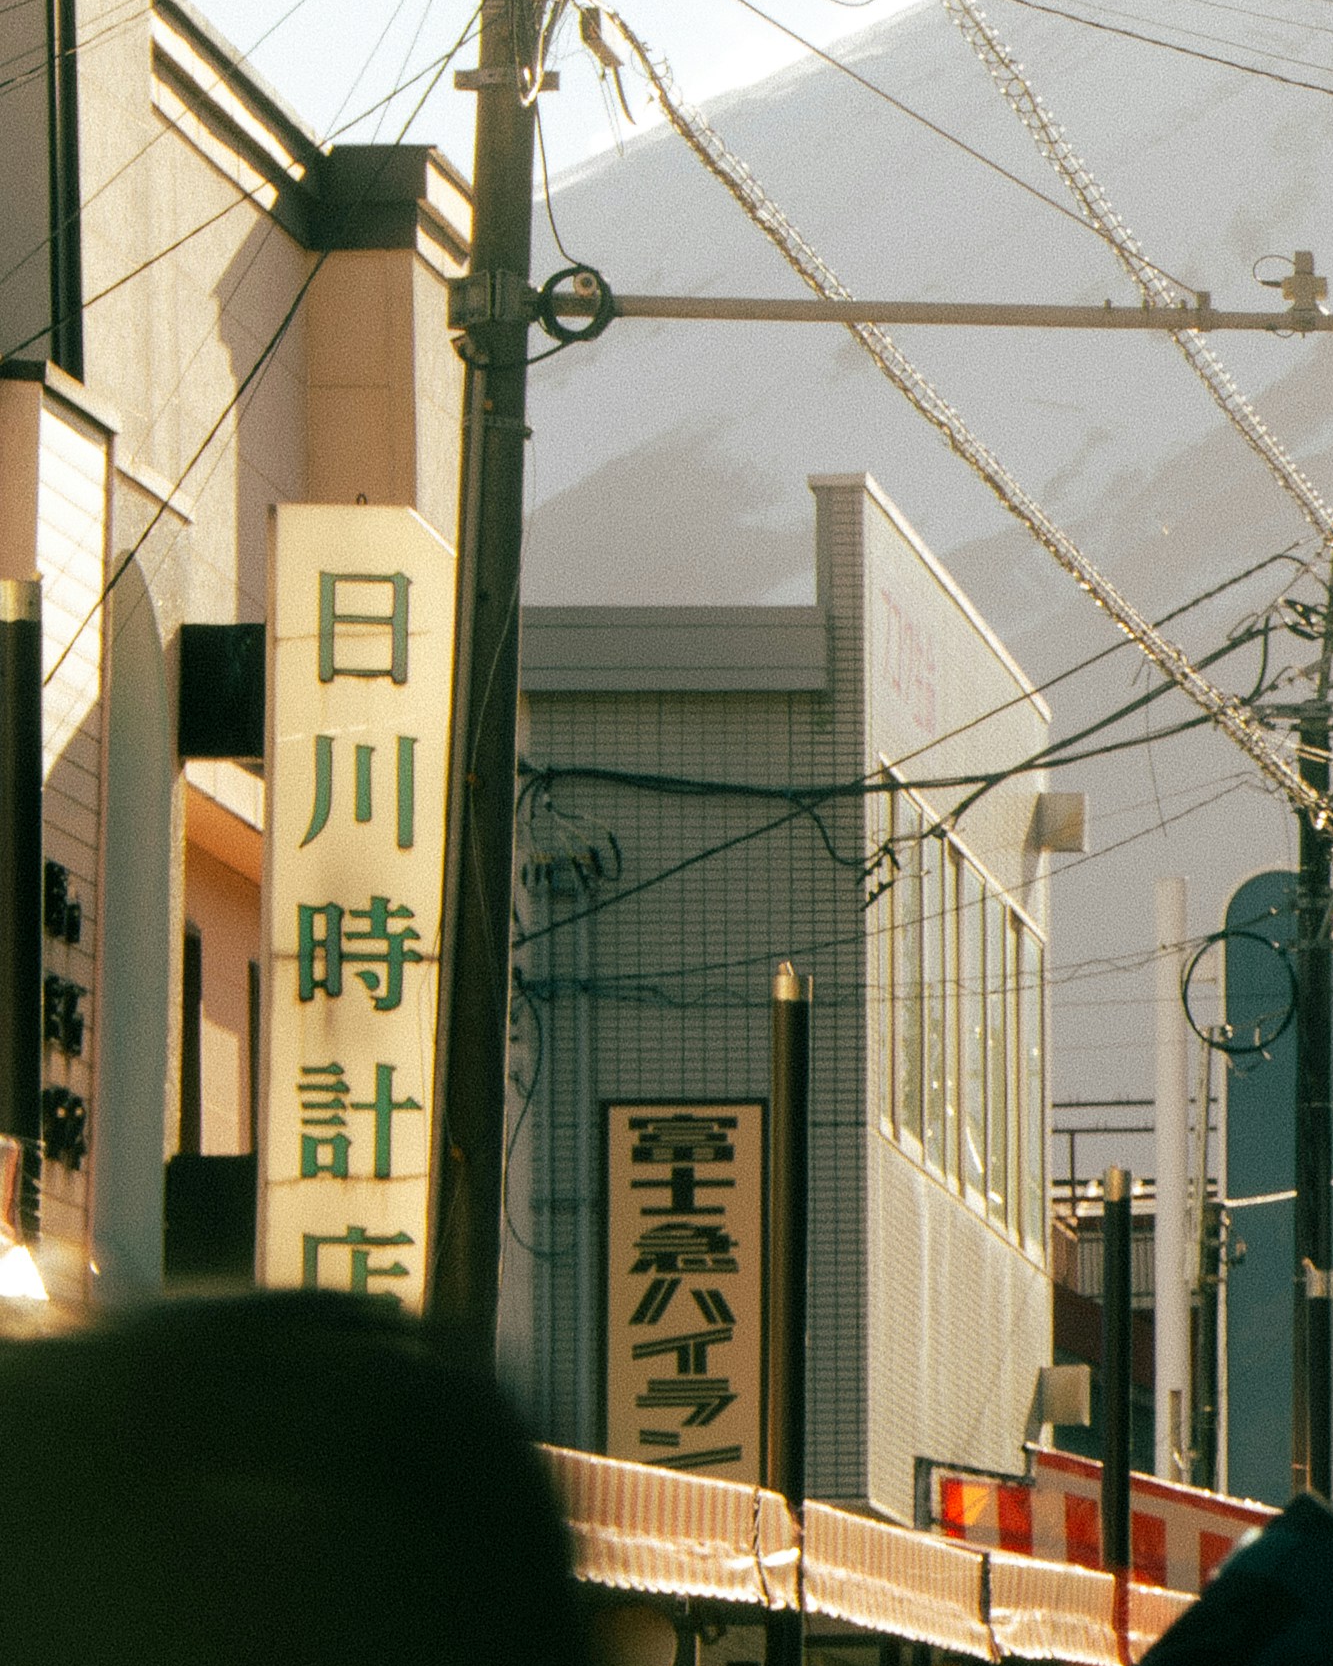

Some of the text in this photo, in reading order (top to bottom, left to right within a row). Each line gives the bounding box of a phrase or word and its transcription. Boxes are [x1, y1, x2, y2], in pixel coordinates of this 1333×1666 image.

[298, 570, 423, 1297] 日川時計店
